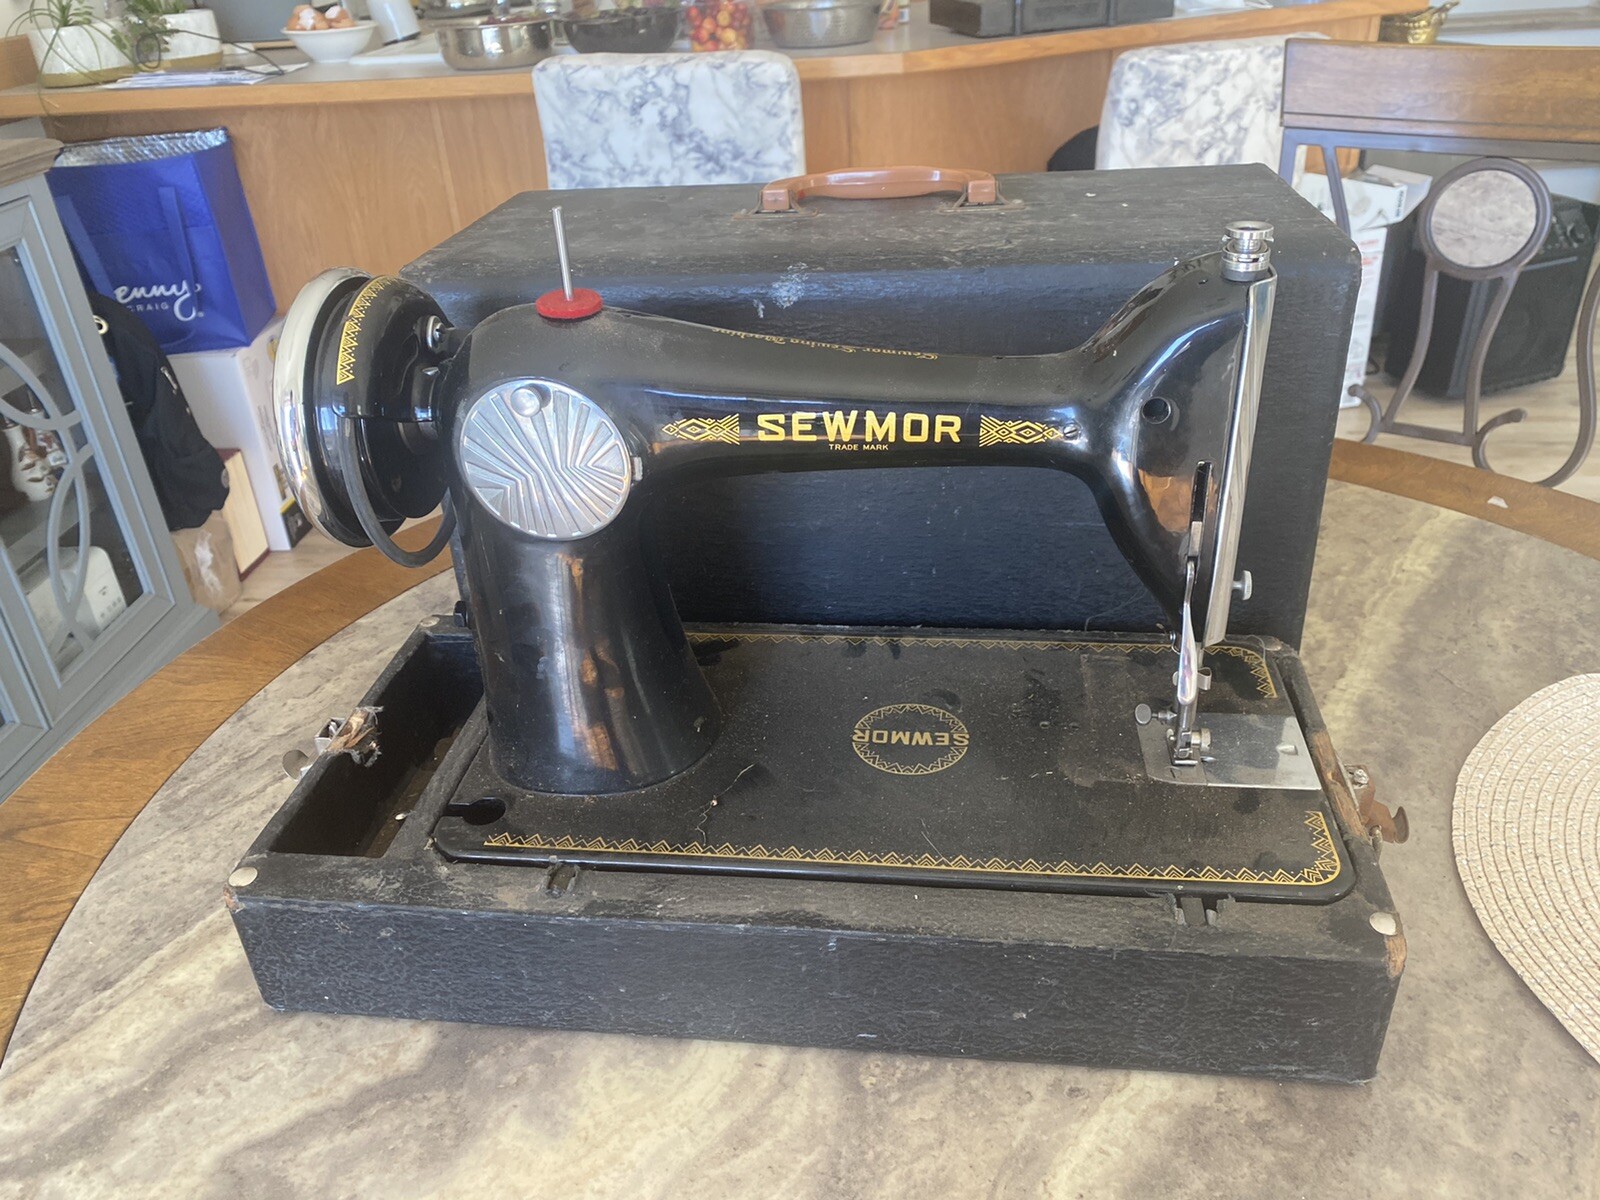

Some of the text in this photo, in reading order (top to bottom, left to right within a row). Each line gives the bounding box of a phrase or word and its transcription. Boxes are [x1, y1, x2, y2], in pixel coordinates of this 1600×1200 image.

[113, 280, 201, 321] enny
[757, 410, 961, 443] SEWMOR
[829, 443, 858, 451] TRADE
[852, 730, 970, 746] SEWMOR
